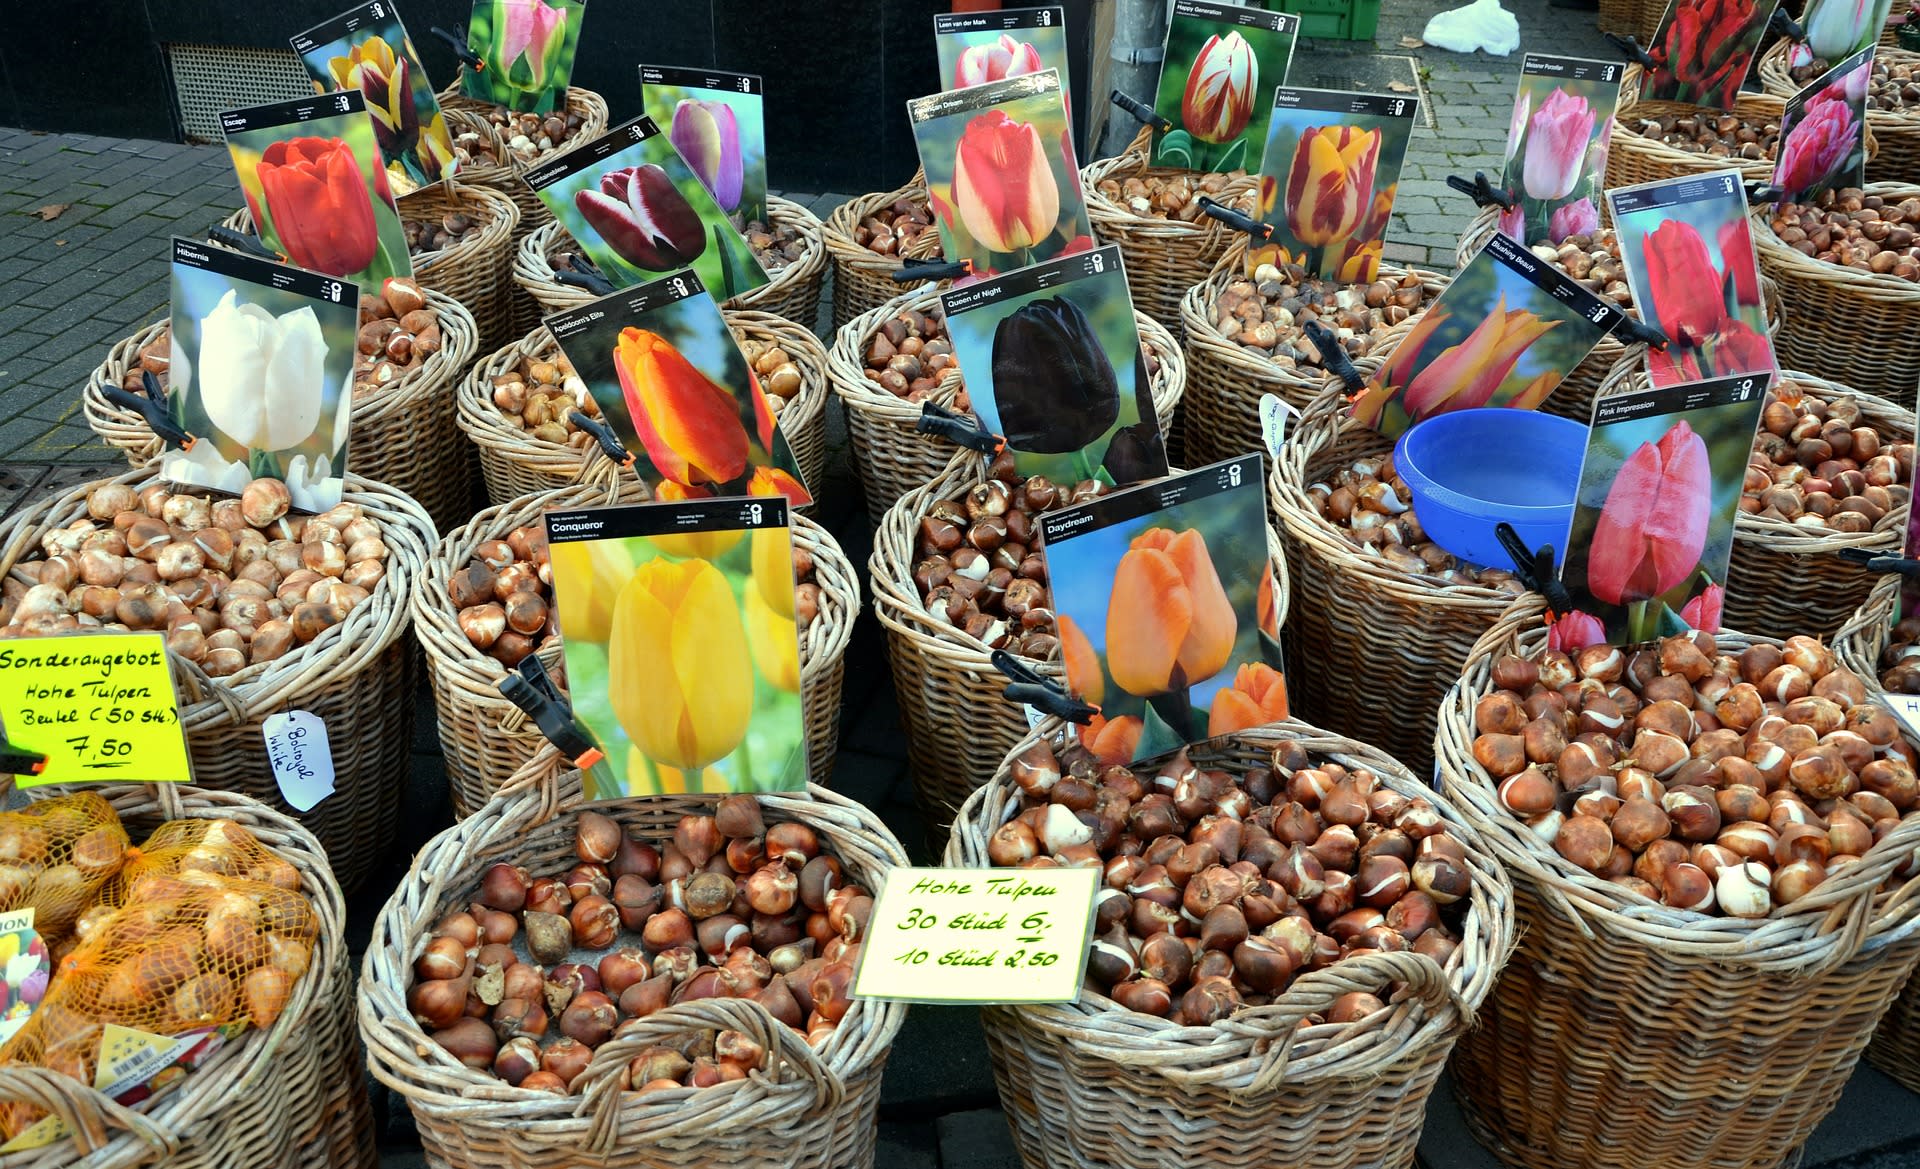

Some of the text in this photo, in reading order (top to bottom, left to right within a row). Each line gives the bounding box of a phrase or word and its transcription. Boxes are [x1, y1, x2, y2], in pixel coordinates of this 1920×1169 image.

[1176, 4, 1194, 13] Happy
[1195, 6, 1222, 16] Generation
[943, 99, 964, 109] Dream
[223, 118, 247, 127] Escape
[530, 164, 569, 186] Fontainebleau
[177, 247, 210, 262] Hibernia
[1491, 240, 1516, 261] Blushing
[1515, 255, 1537, 273] Beauty
[947, 296, 972, 308] Queen
[972, 292, 981, 301] of
[981, 287, 1002, 298] Night
[553, 315, 591, 334] Apeldoorn's
[589, 310, 605, 322] Elite
[1598, 407, 1616, 417] Pink
[1616, 401, 1656, 414] Impression
[551, 521, 605, 533] Conqueror
[1047, 514, 1095, 534] Daydream
[0, 649, 162, 677] Sonderangebot
[25, 680, 152, 705] Hohe Tulpen
[19, 709, 80, 726] Beutel
[65, 735, 133, 761] 7,50
[268, 734, 289, 771] White
[908, 876, 1058, 902] Hohe Tulpen
[896, 907, 937, 931] 30
[894, 948, 929, 967] 10
